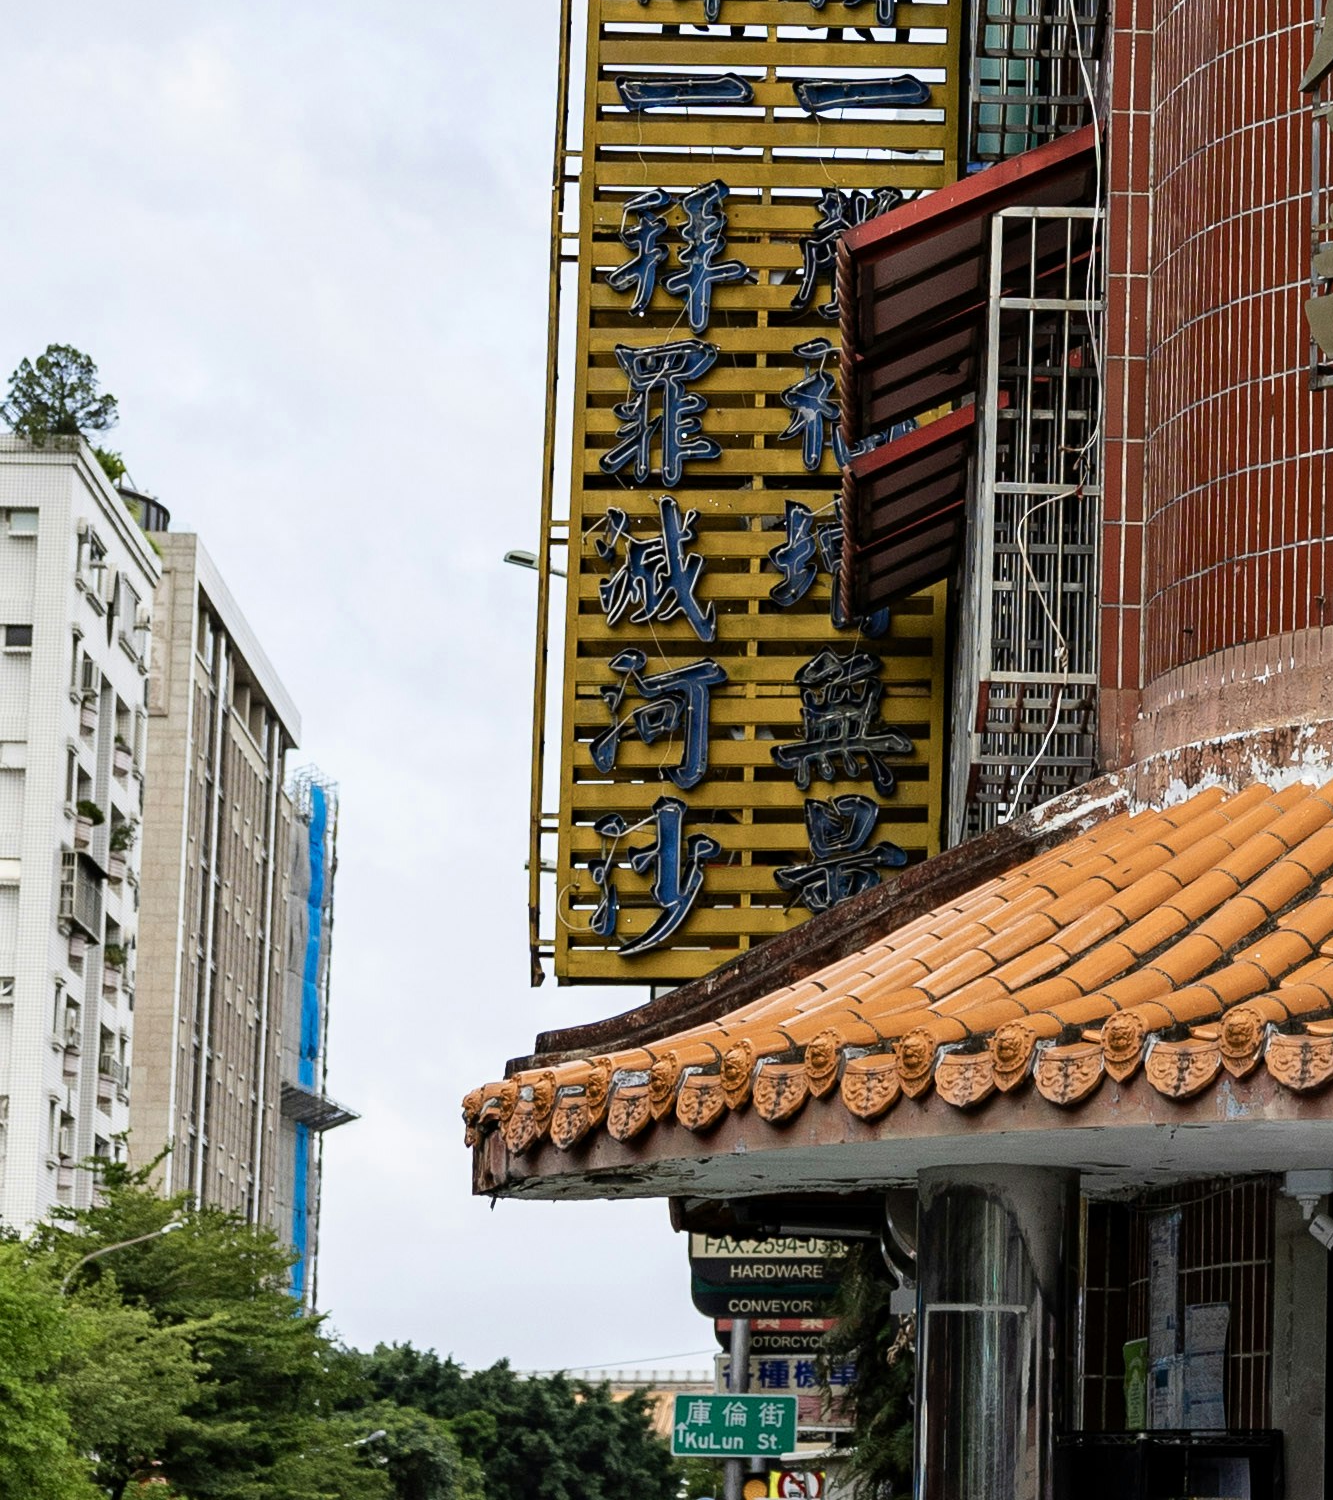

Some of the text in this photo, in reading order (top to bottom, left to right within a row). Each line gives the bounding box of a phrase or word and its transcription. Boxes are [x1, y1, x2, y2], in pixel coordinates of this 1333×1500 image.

[730, 1264, 823, 1279] HARDWARE
[728, 1299, 813, 1313] CONVEYOR
[750, 1336, 825, 1349] OTORCYCL
[722, 1361, 858, 1389] 種機車
[686, 1399, 785, 1428] 庫倫街
[685, 1432, 743, 1450] KuLun
[757, 1432, 782, 1450] St.
